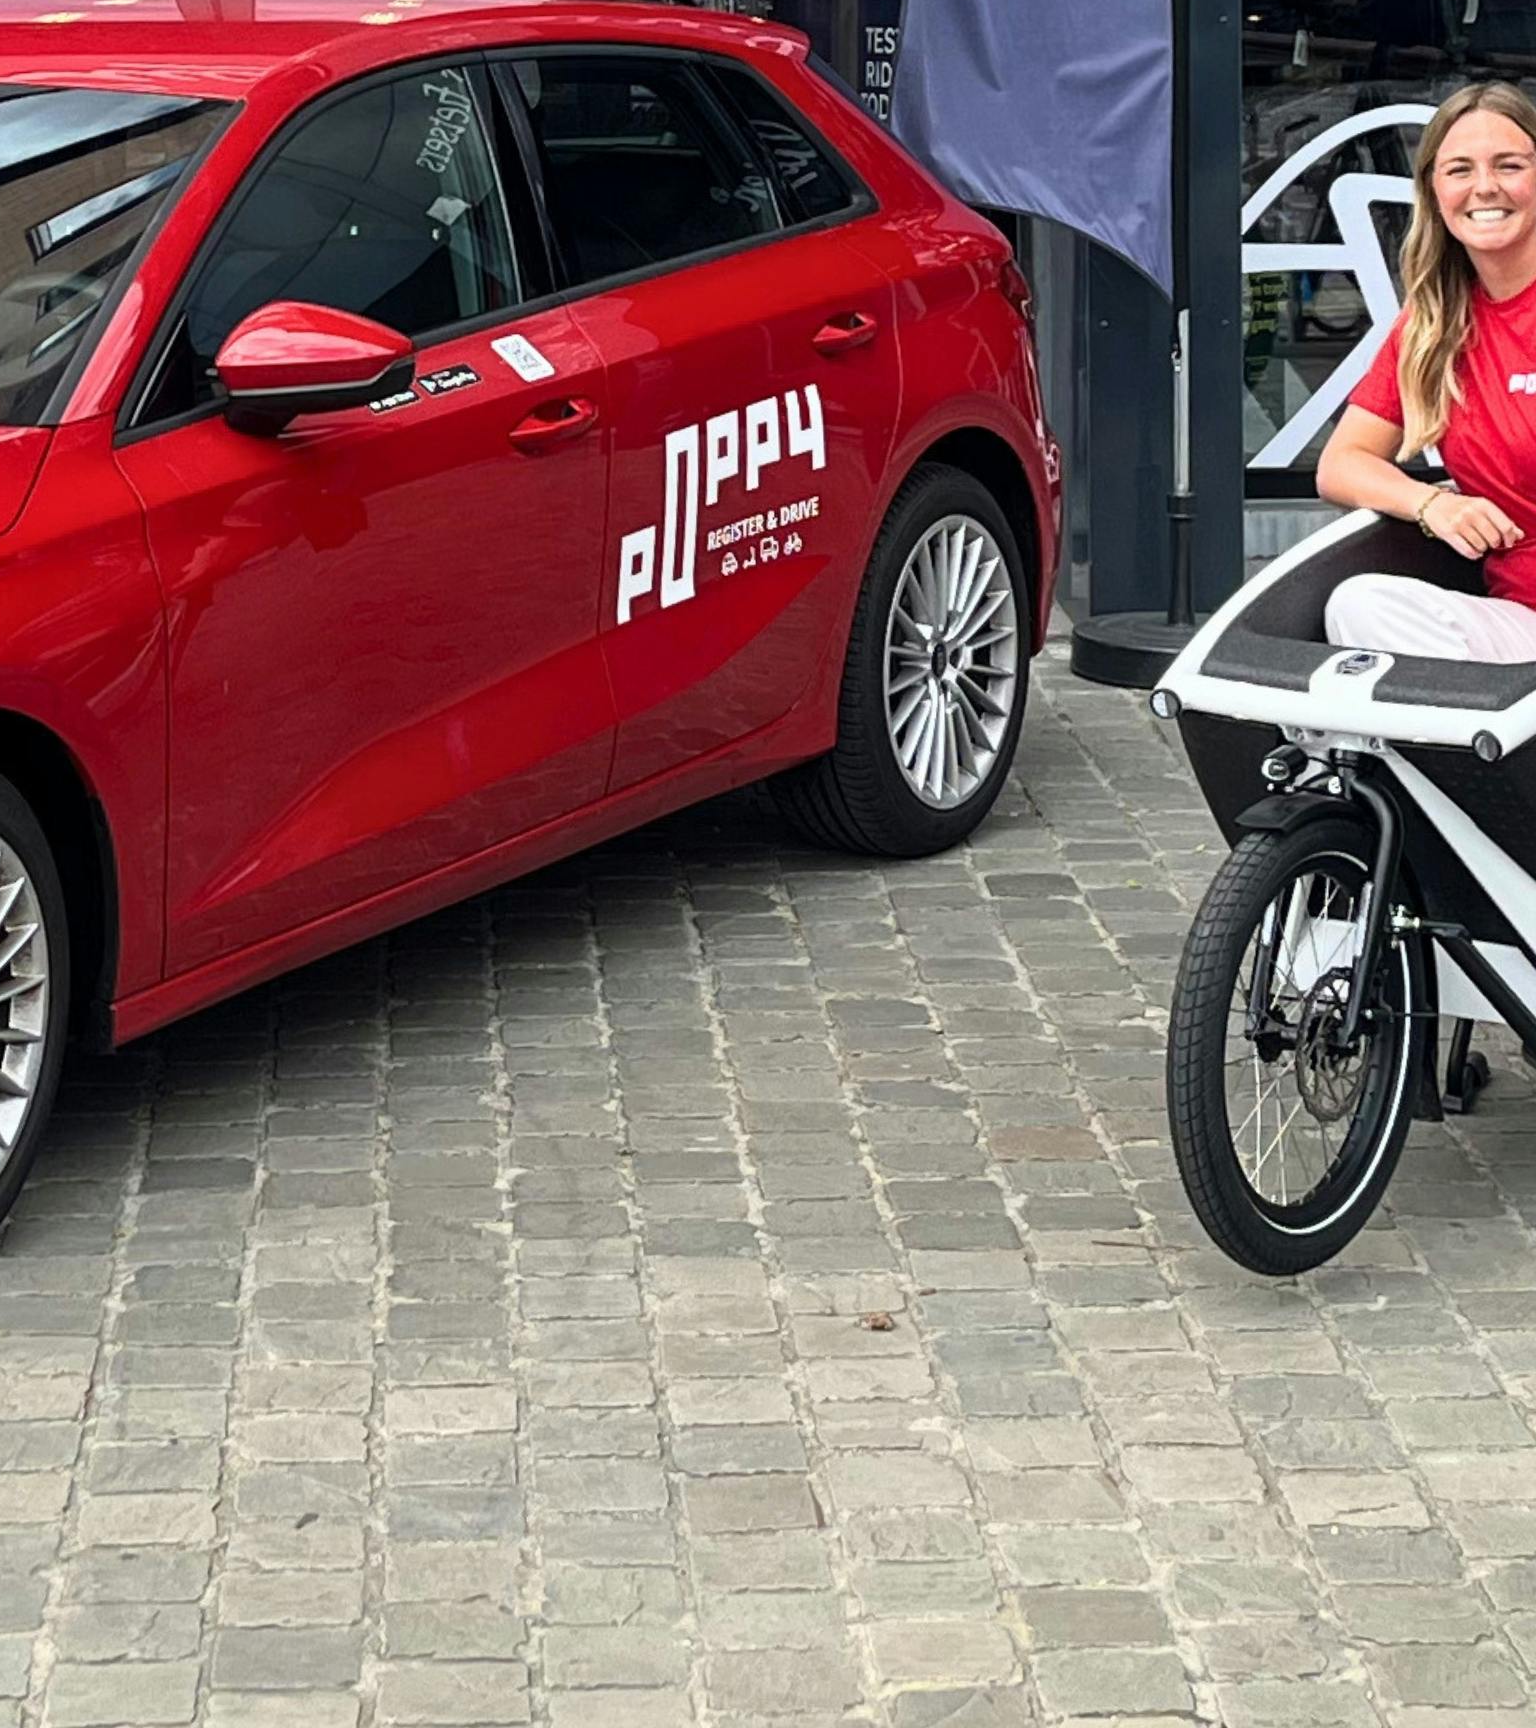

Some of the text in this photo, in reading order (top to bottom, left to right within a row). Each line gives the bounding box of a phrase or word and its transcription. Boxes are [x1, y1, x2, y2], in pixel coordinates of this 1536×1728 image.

[707, 495, 820, 552] REGISTER & DRIVE
